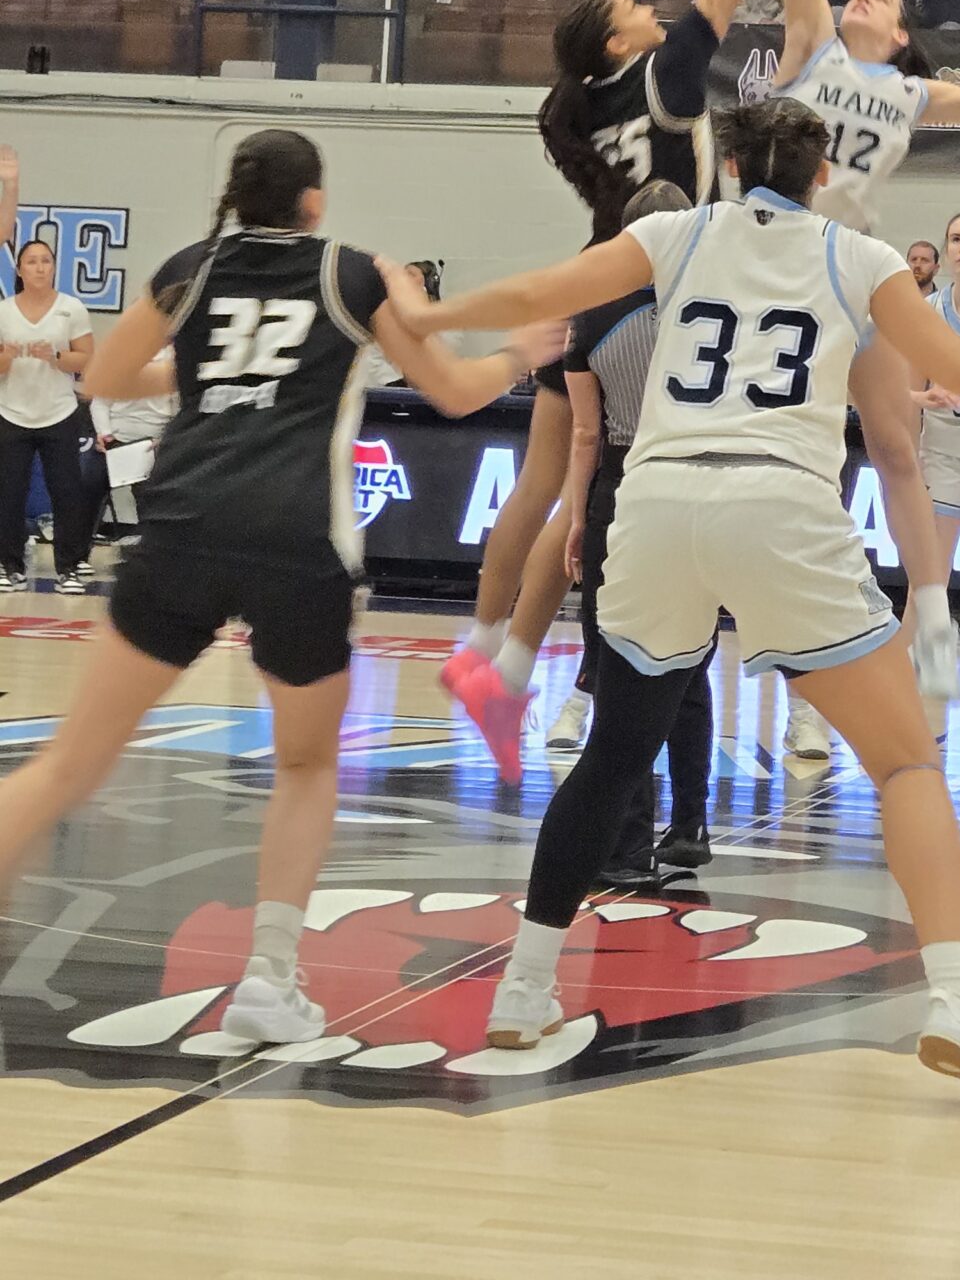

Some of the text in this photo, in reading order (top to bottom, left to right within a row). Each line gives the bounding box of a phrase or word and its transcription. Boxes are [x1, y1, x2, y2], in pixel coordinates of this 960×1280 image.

[828, 122, 880, 173] 12
[197, 296, 318, 381] 32
[664, 297, 823, 411] 33
